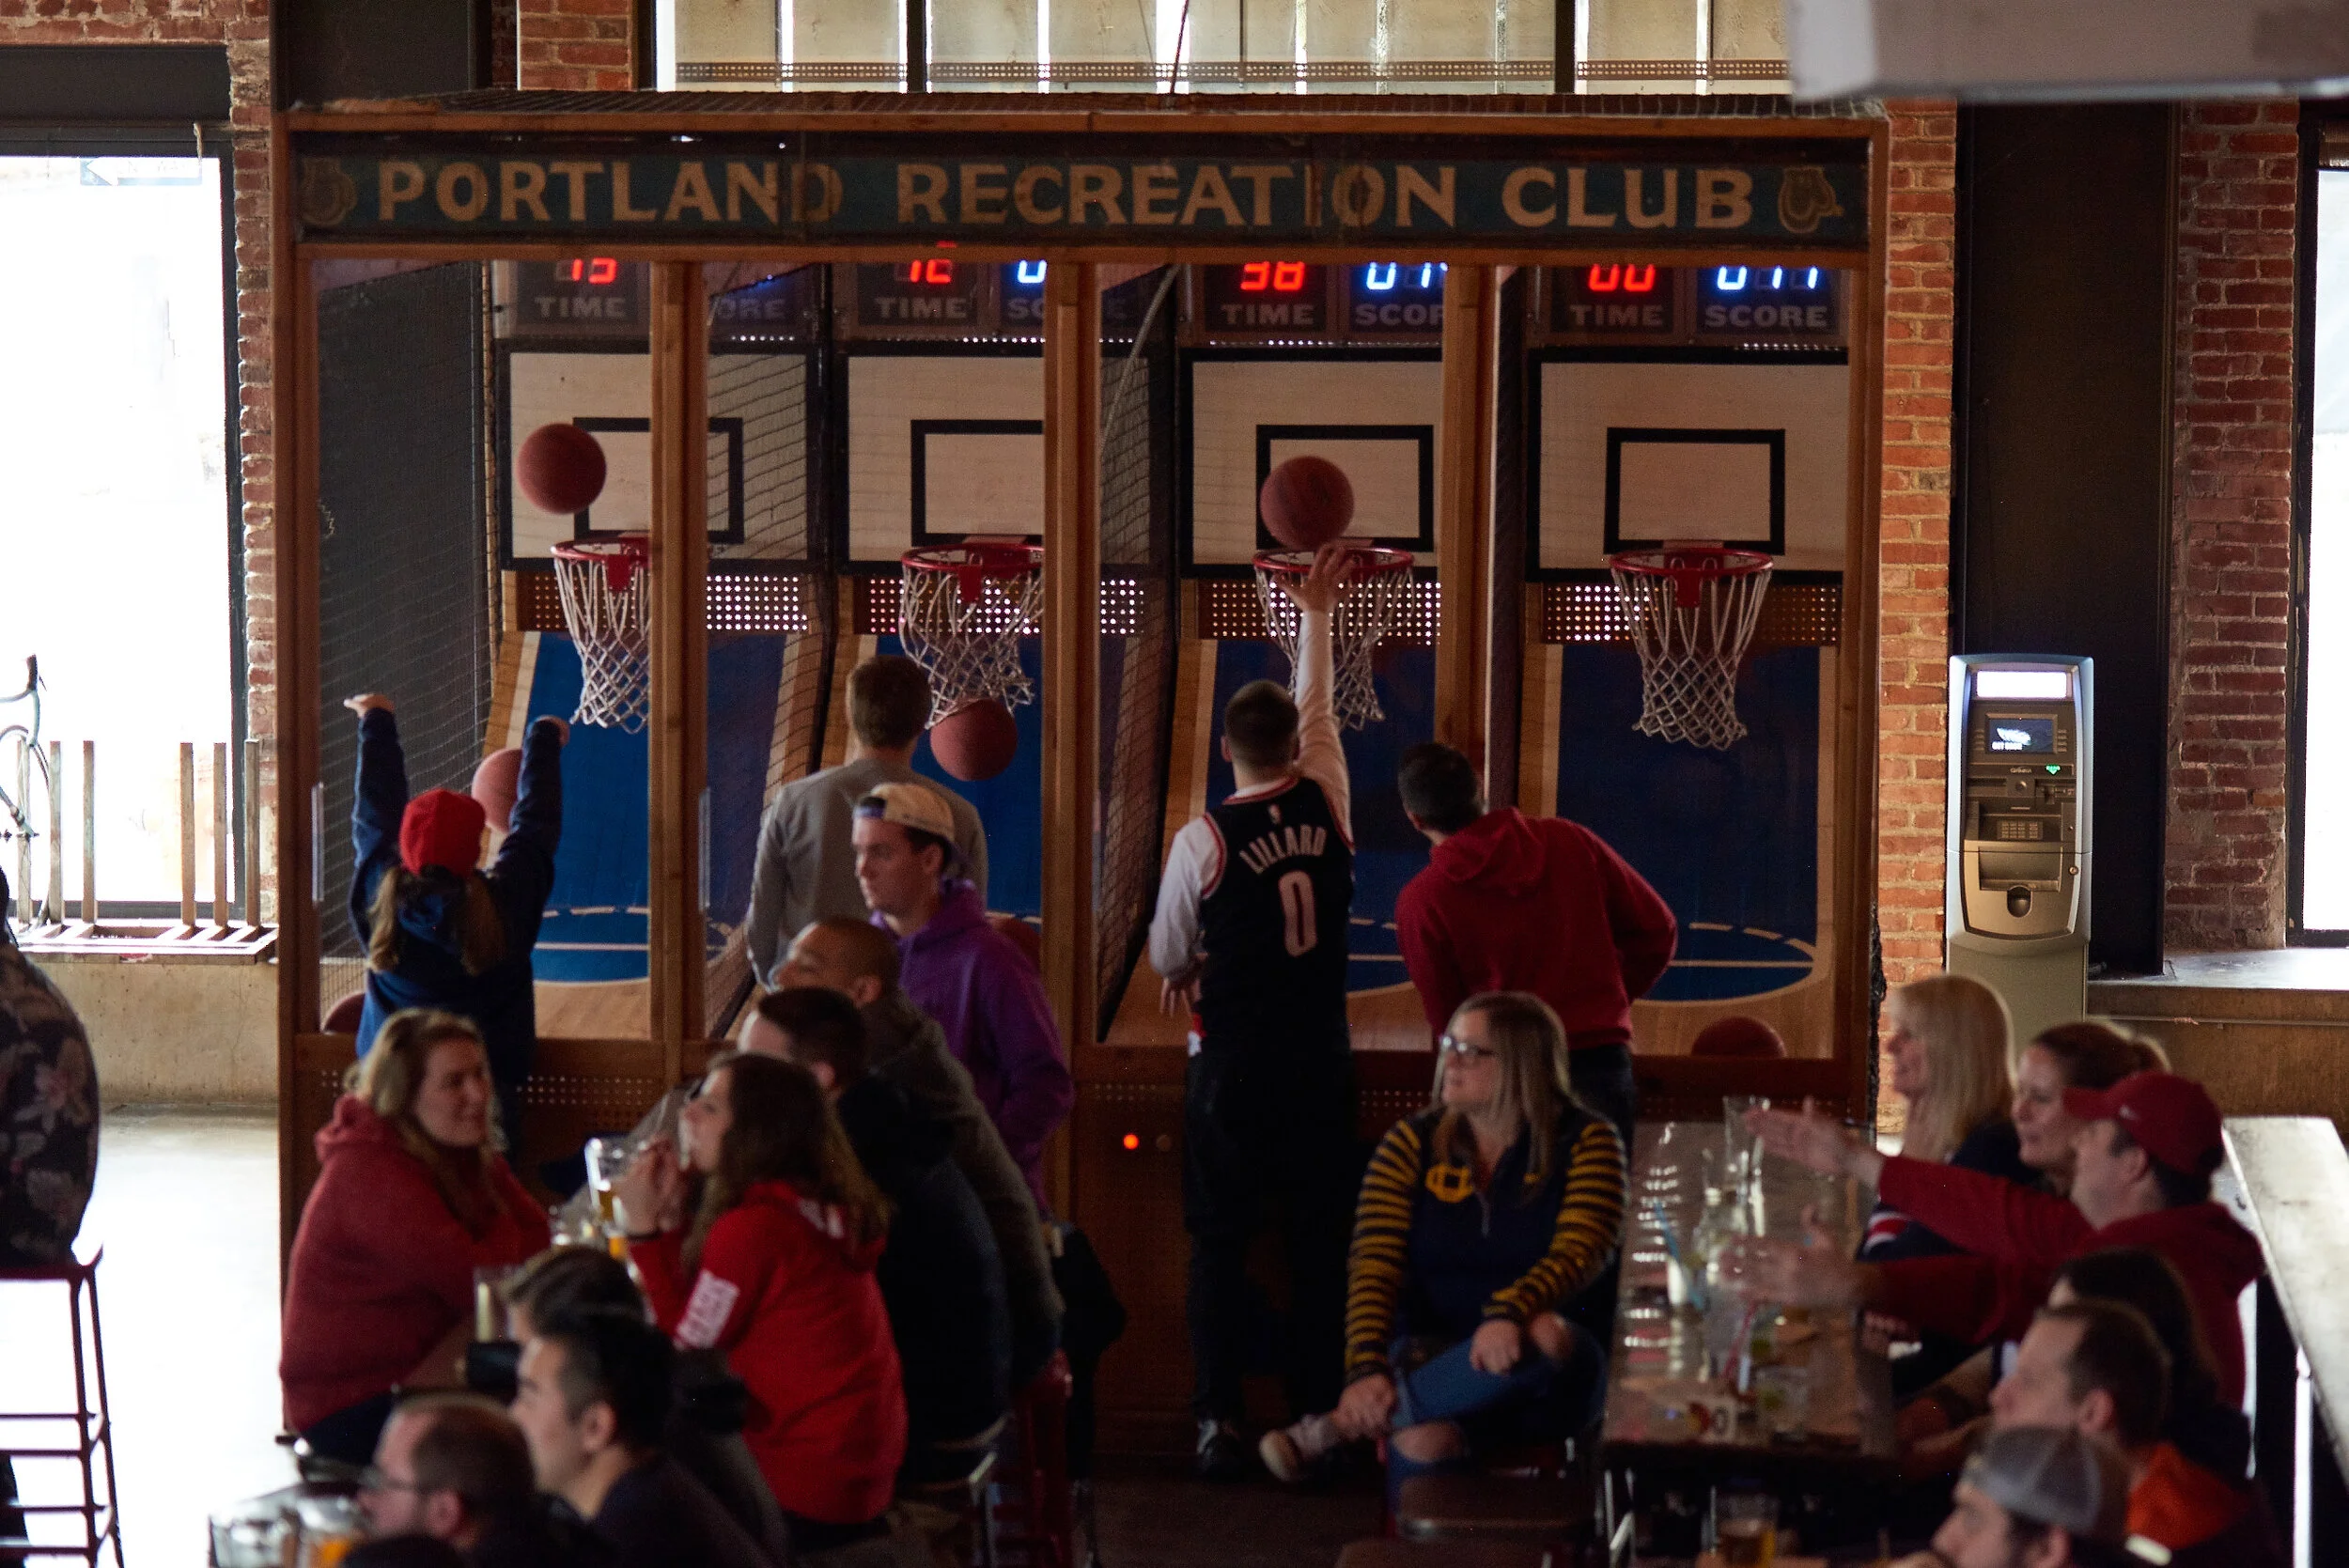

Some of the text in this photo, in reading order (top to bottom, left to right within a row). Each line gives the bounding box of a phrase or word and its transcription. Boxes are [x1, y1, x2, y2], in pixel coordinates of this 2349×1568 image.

[378, 161, 1754, 229] PORTLAND RECREATION CLUB
[534, 296, 626, 318] TIME
[874, 296, 967, 319] TIME
[1222, 303, 1315, 326] TIME
[1569, 303, 1664, 327] TIME
[1703, 304, 1828, 329] SCORE
[1238, 823, 1328, 875] LILLARD
[1278, 869, 1318, 957] 0
